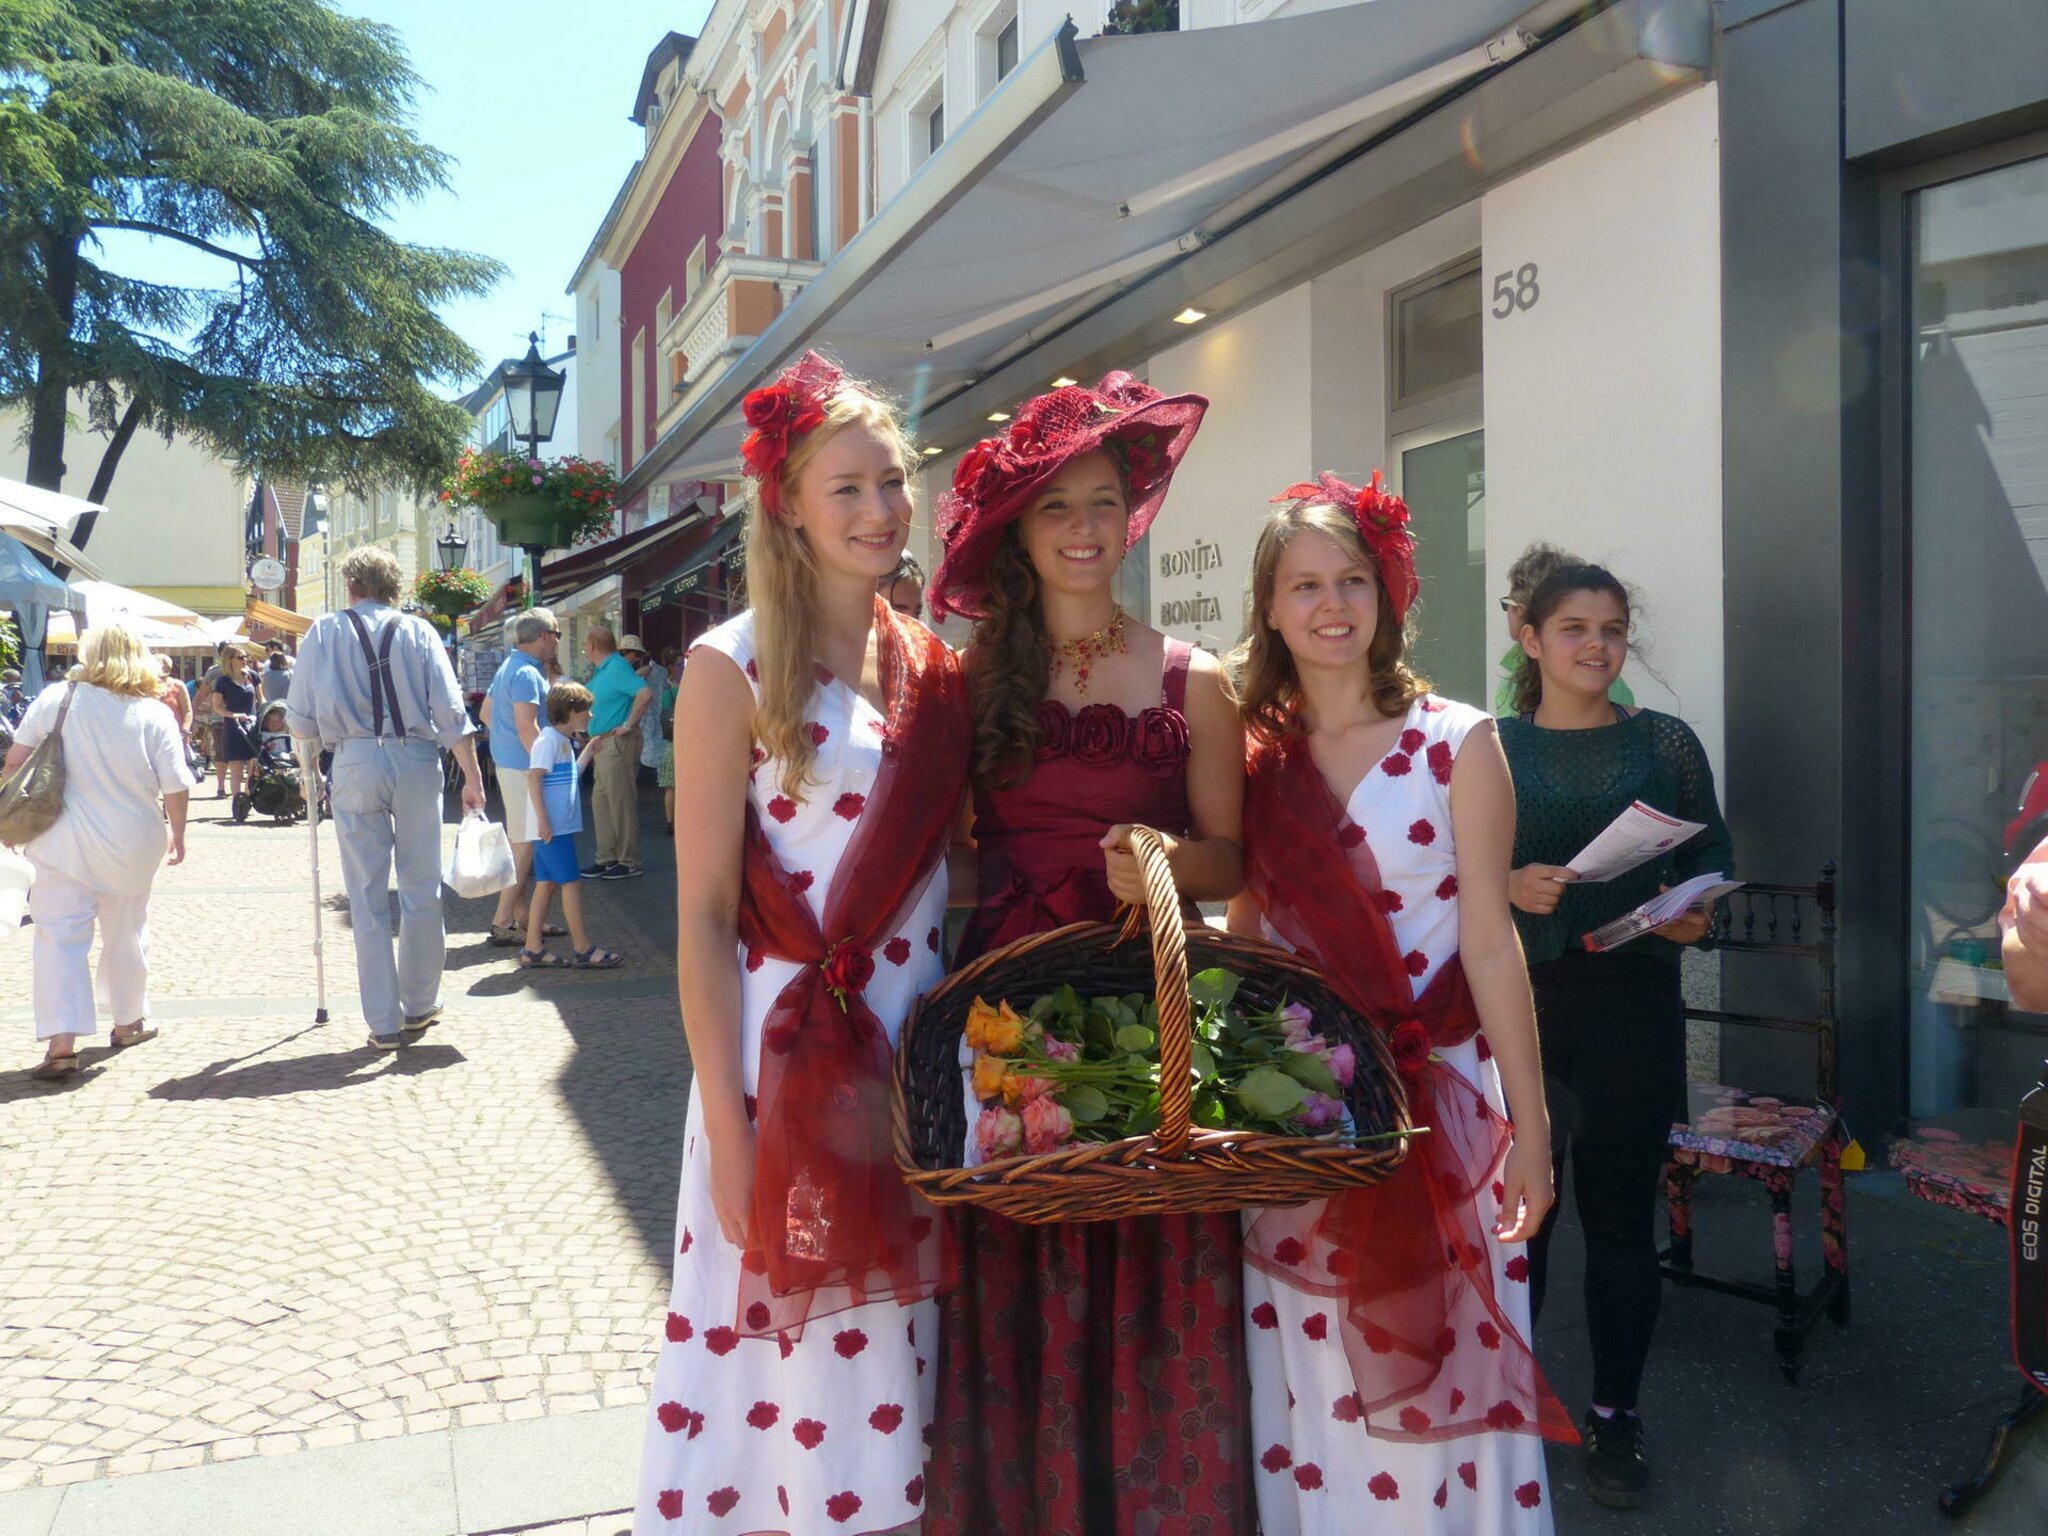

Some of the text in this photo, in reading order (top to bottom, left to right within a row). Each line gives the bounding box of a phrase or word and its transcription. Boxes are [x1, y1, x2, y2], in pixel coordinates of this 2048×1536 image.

[1492, 262, 1540, 319] 58
[1160, 539, 1222, 579] BONITA
[1160, 591, 1222, 630] BONITA
[2022, 1145, 2048, 1262] EOS DIGITAL
